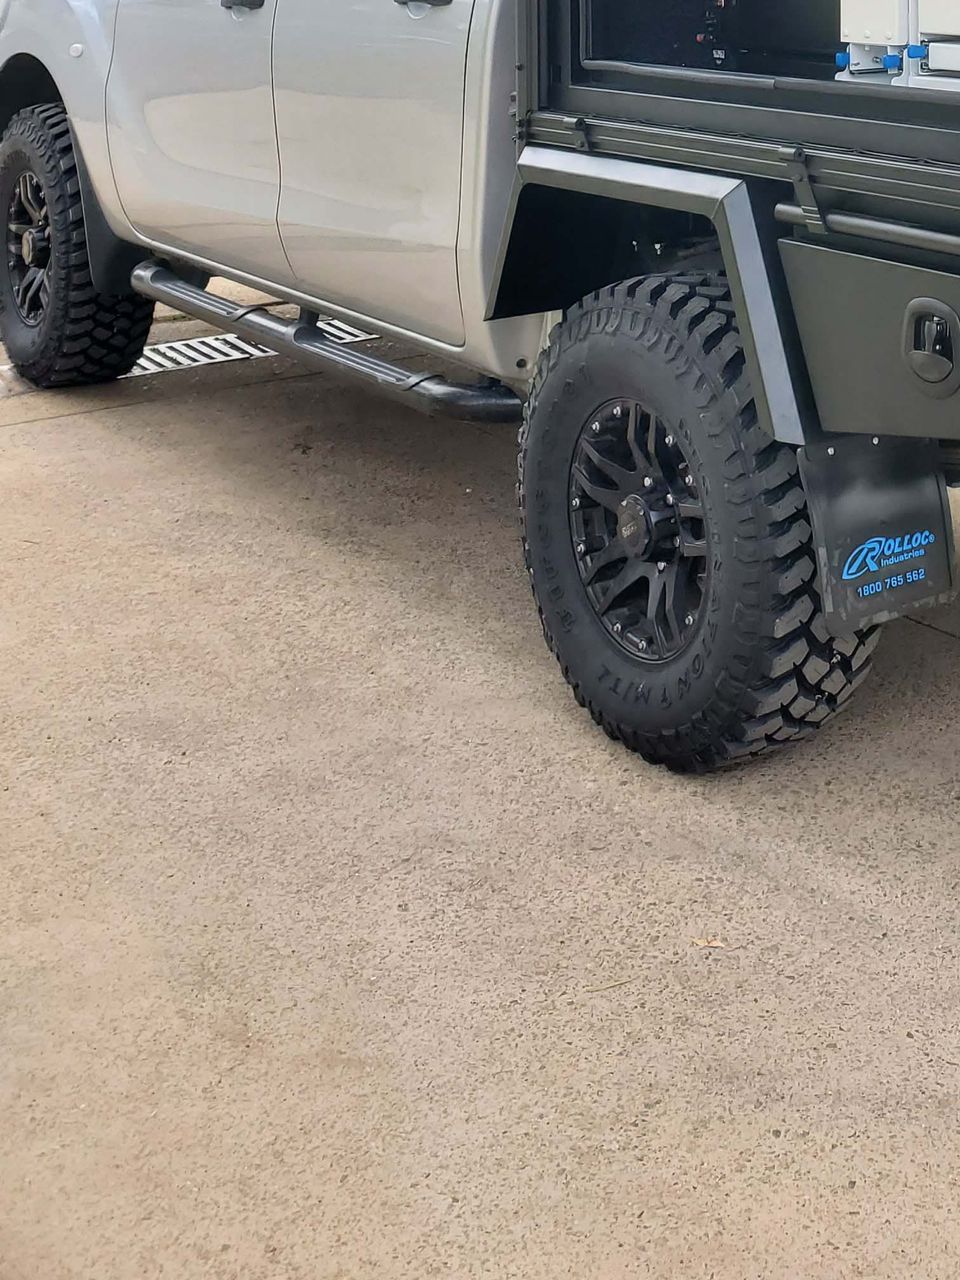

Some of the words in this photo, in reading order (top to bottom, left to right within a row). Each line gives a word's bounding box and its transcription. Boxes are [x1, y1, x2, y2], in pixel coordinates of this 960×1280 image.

[880, 548, 926, 568] Industries
[857, 581, 882, 598] 1800
[884, 575, 904, 589] 765
[906, 568, 926, 583] 562
